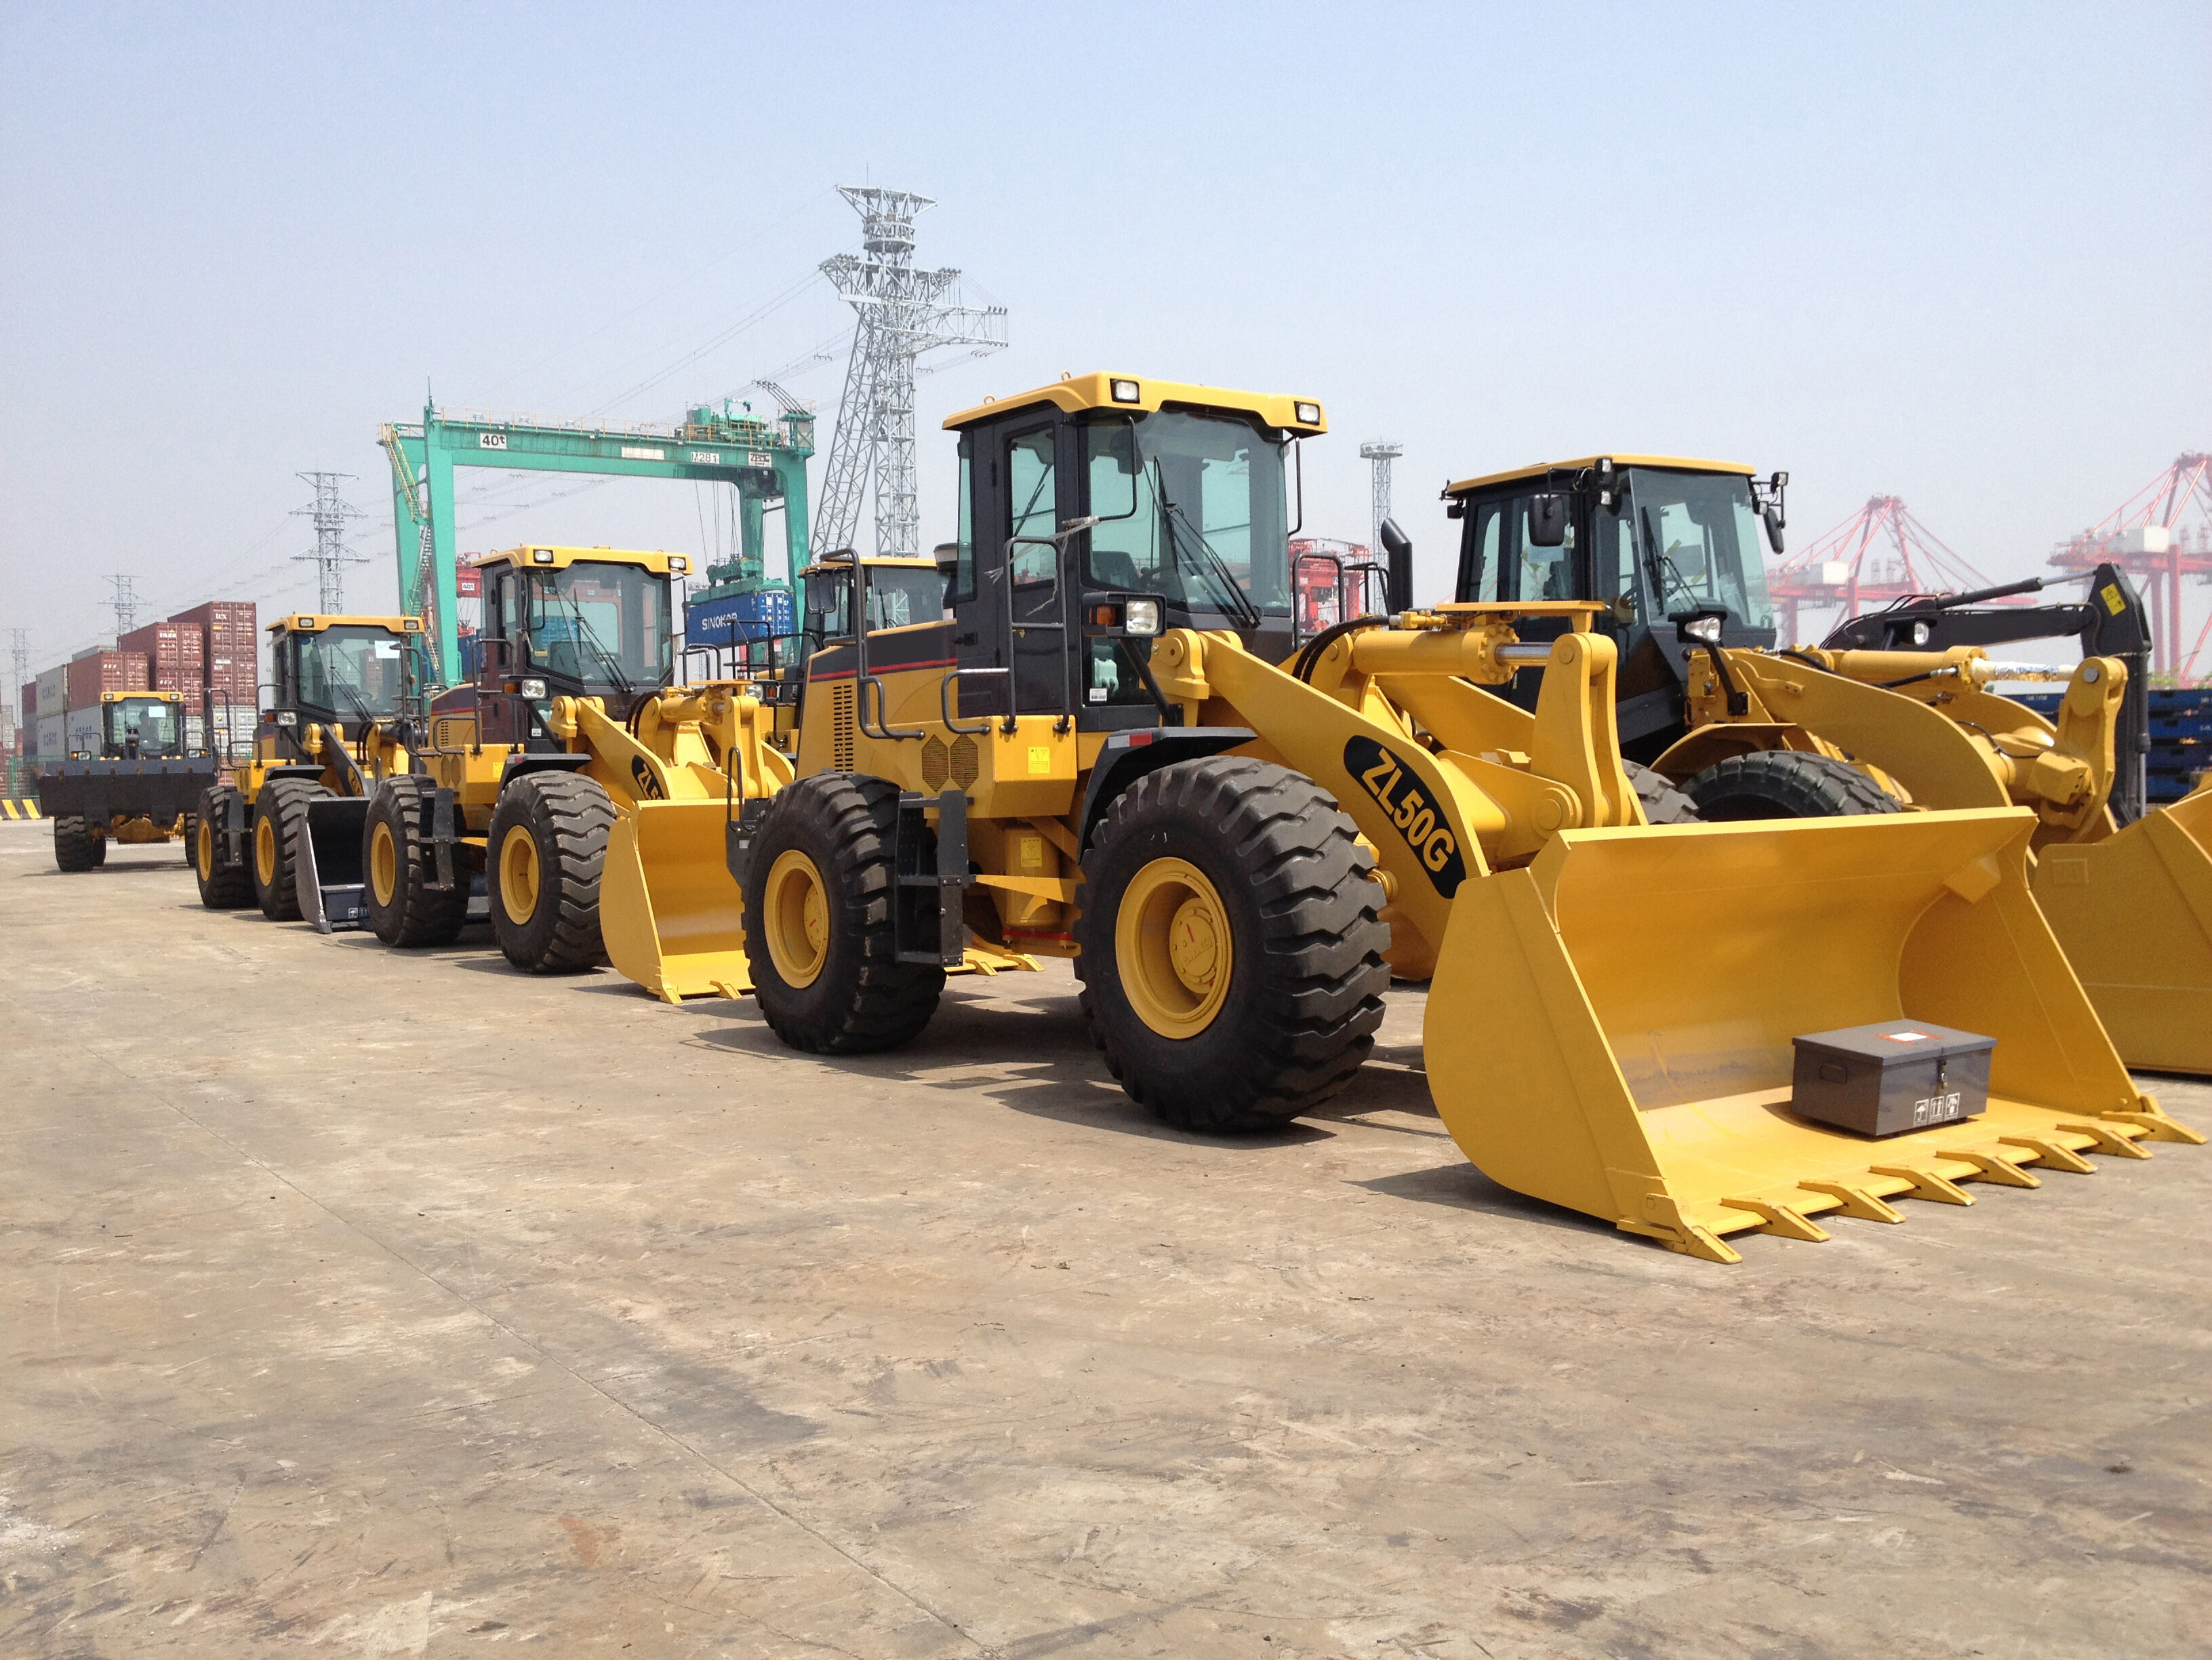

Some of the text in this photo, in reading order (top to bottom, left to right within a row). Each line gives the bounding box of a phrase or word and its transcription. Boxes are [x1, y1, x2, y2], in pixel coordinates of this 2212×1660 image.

[483, 435, 505, 446] 40t
[691, 453, 717, 463] M281
[637, 763, 662, 800] ZL5
[1362, 748, 1455, 872] ZL50G
